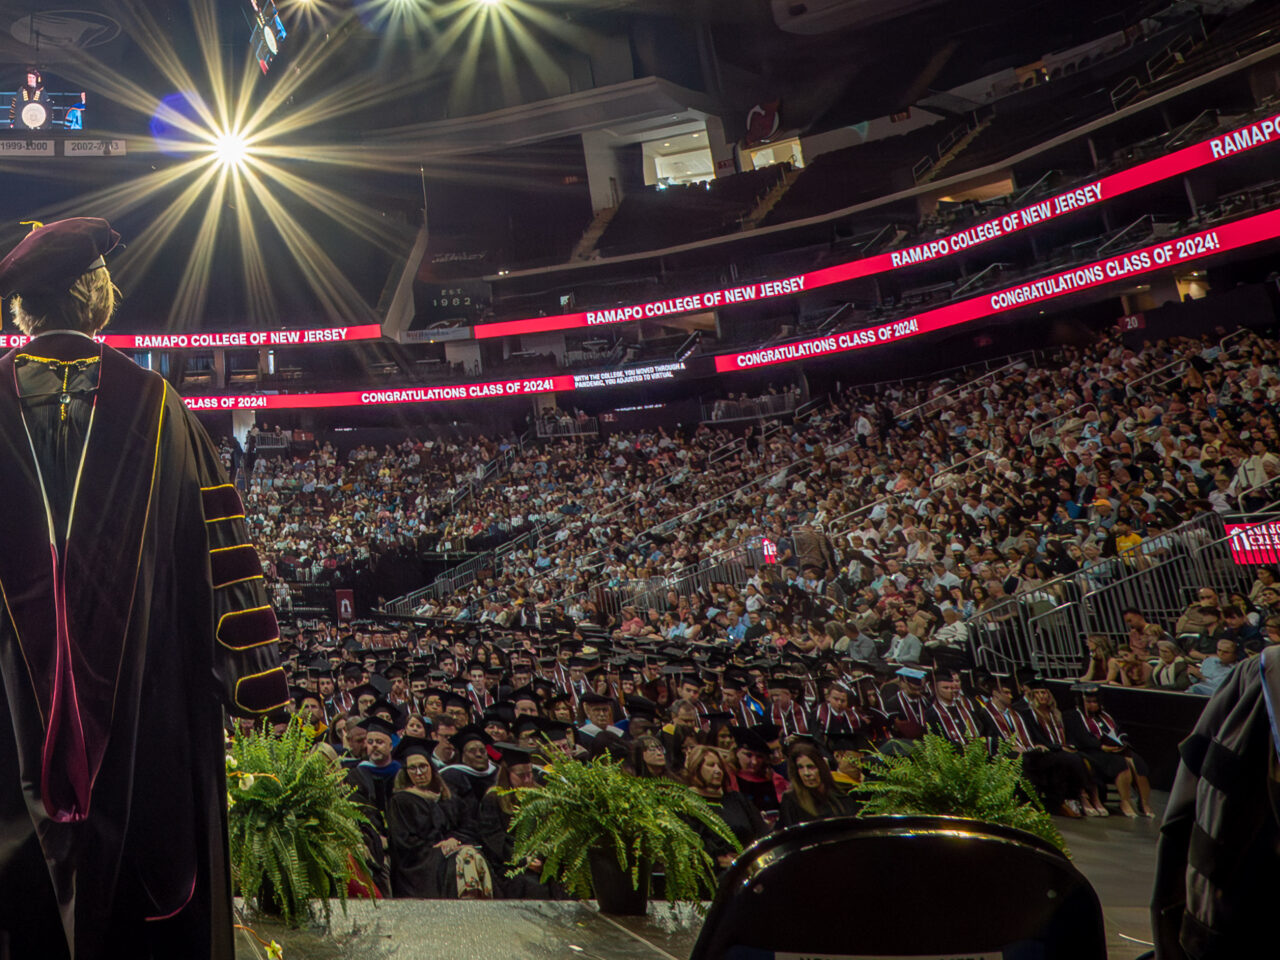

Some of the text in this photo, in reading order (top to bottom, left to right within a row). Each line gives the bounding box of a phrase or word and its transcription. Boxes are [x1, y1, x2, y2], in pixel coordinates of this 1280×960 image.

[71, 142, 119, 151] 2002-23
[891, 183, 1103, 267] RAMAPO COLLEGE OF NEW JERSEY
[990, 231, 1220, 311] CONGRATULATIONS CLASS OF 2024!
[586, 276, 805, 325] RAMAPO COLLEGE OF NEW JERSEY
[1125, 317, 1138, 329] 20
[10, 336, 27, 347] OF
[135, 328, 347, 347] RAMAPO COLLEGE OF NEW JERSEY
[737, 318, 919, 367] CONGRATULATIONS CLASS OF 2024!
[590, 373, 600, 381] THE
[624, 369, 636, 377] YOU
[605, 378, 616, 386] YOU
[361, 379, 554, 403] CONGRATULATIONS CLASS OF 2024!
[184, 397, 267, 409] CLASS OF 2024!
[604, 413, 614, 422] 22
